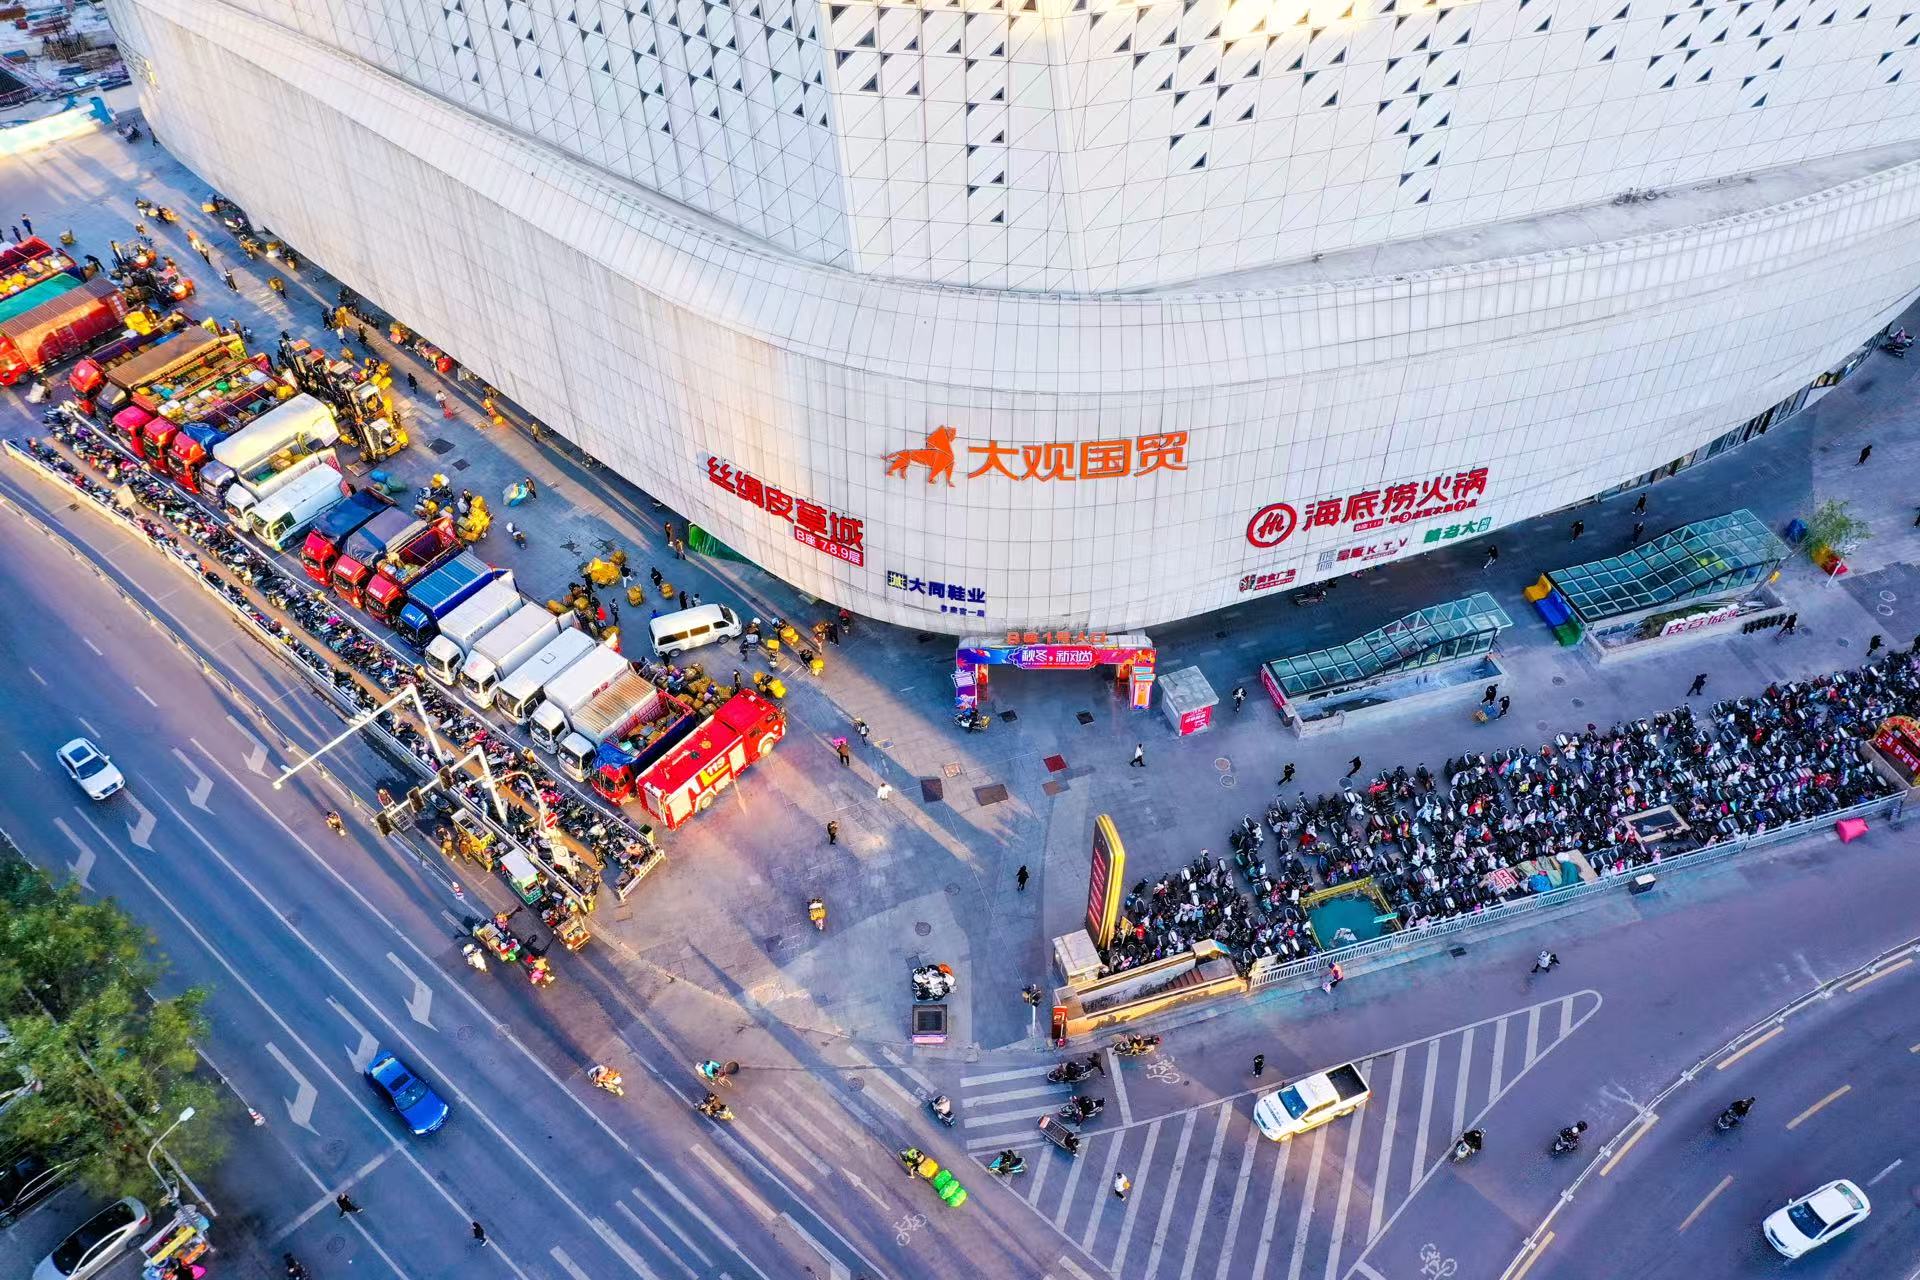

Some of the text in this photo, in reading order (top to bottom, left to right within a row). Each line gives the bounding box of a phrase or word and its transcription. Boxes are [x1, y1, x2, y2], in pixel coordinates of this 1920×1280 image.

[967, 431, 1189, 482] 大观国贸
[707, 456, 864, 551] 丝绸皮草城
[1302, 467, 1489, 532] 海底捞火锅
[908, 577, 986, 604] 大同鞋业
